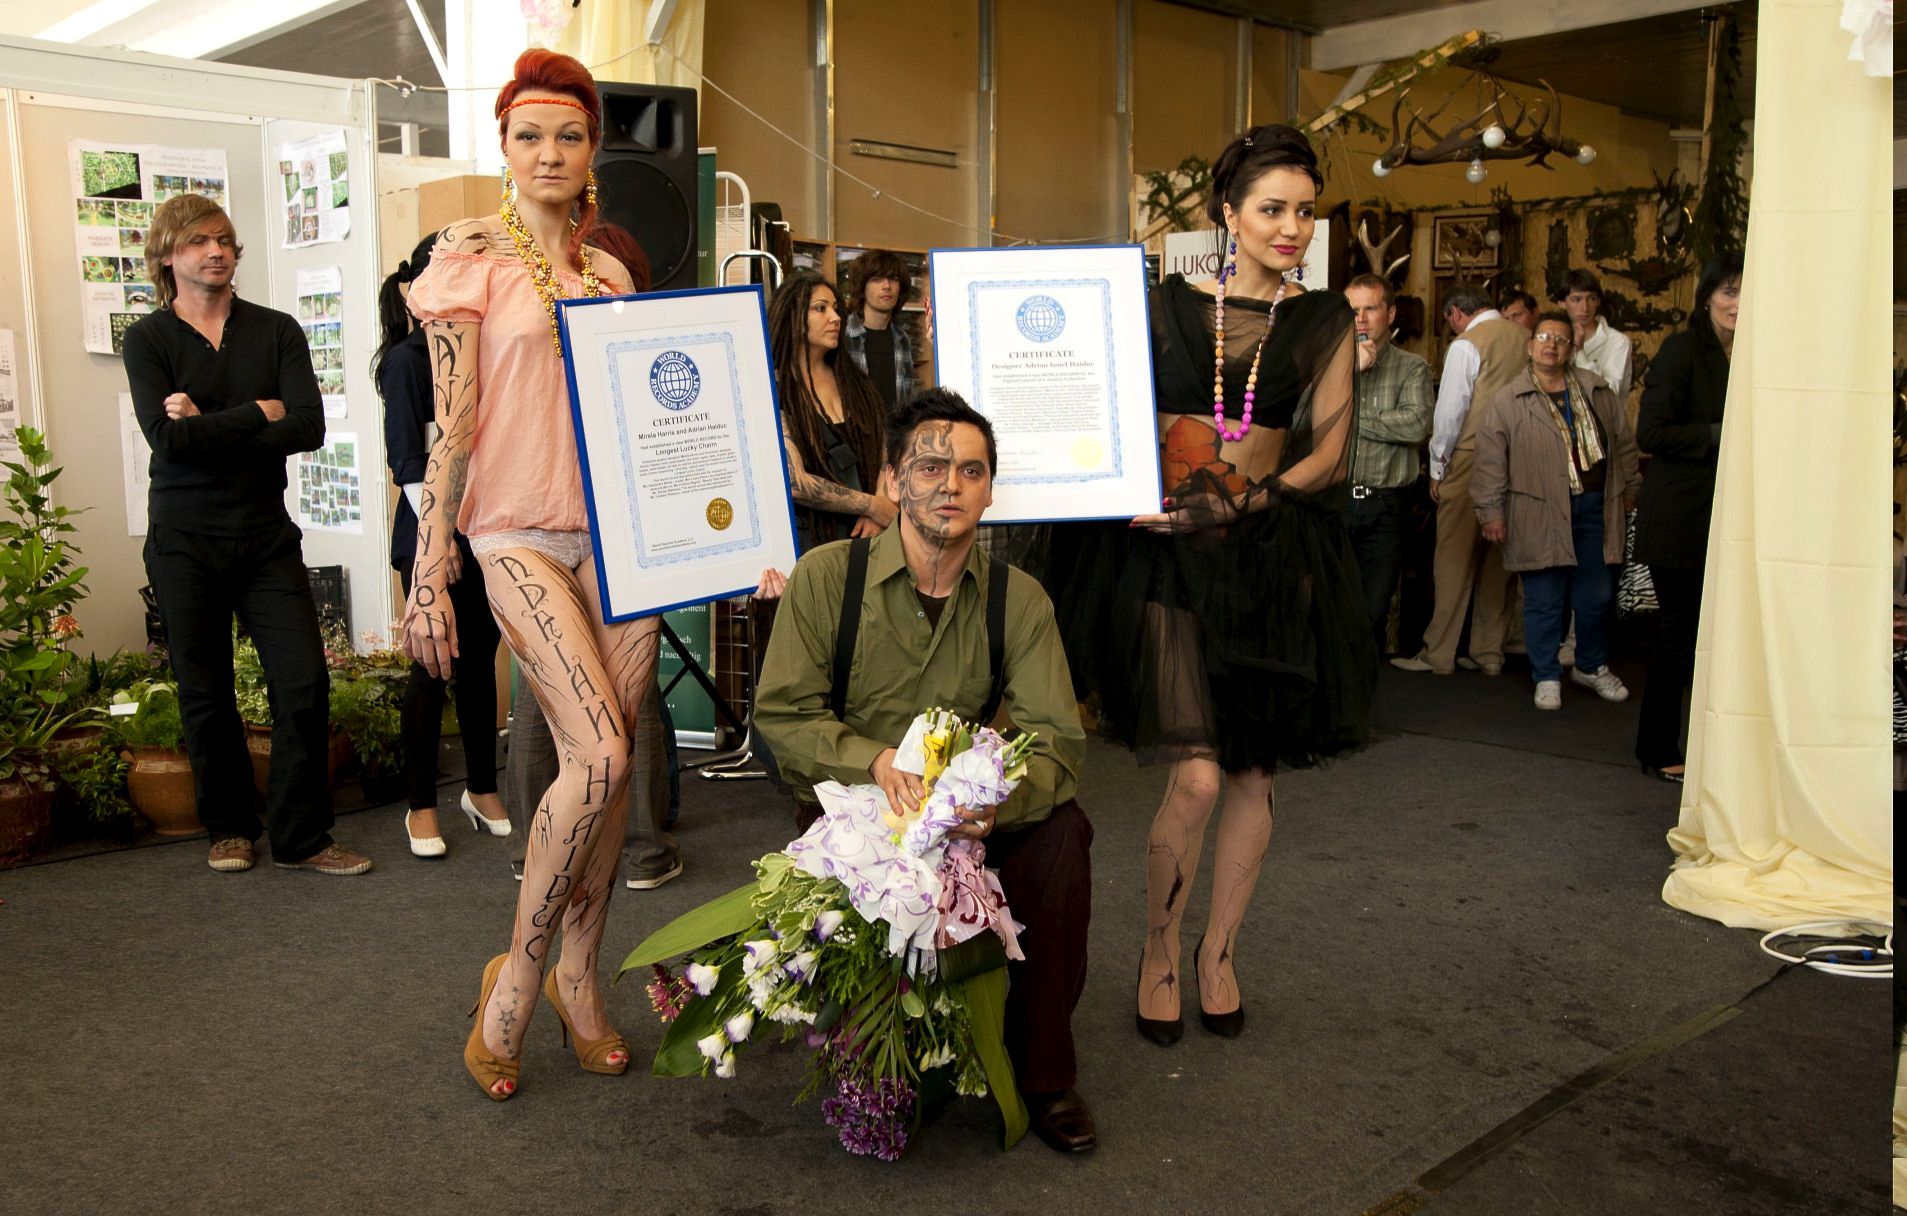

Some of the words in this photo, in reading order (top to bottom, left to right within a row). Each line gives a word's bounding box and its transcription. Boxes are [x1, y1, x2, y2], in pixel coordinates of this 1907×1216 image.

[656, 352, 687, 365] WORLD
[1008, 350, 1075, 360] CERTIFICATE
[991, 362, 1022, 371] Designer
[650, 377, 679, 410] RECORDS
[678, 373, 700, 410] ACADEMY
[652, 412, 711, 427] CERTIFICATE
[657, 429, 675, 438] Harris
[688, 424, 707, 433] Adrian
[655, 446, 679, 456] Longest
[680, 444, 697, 453] Lucky
[698, 441, 718, 450] Charm
[525, 755, 613, 961] HAIDUC
